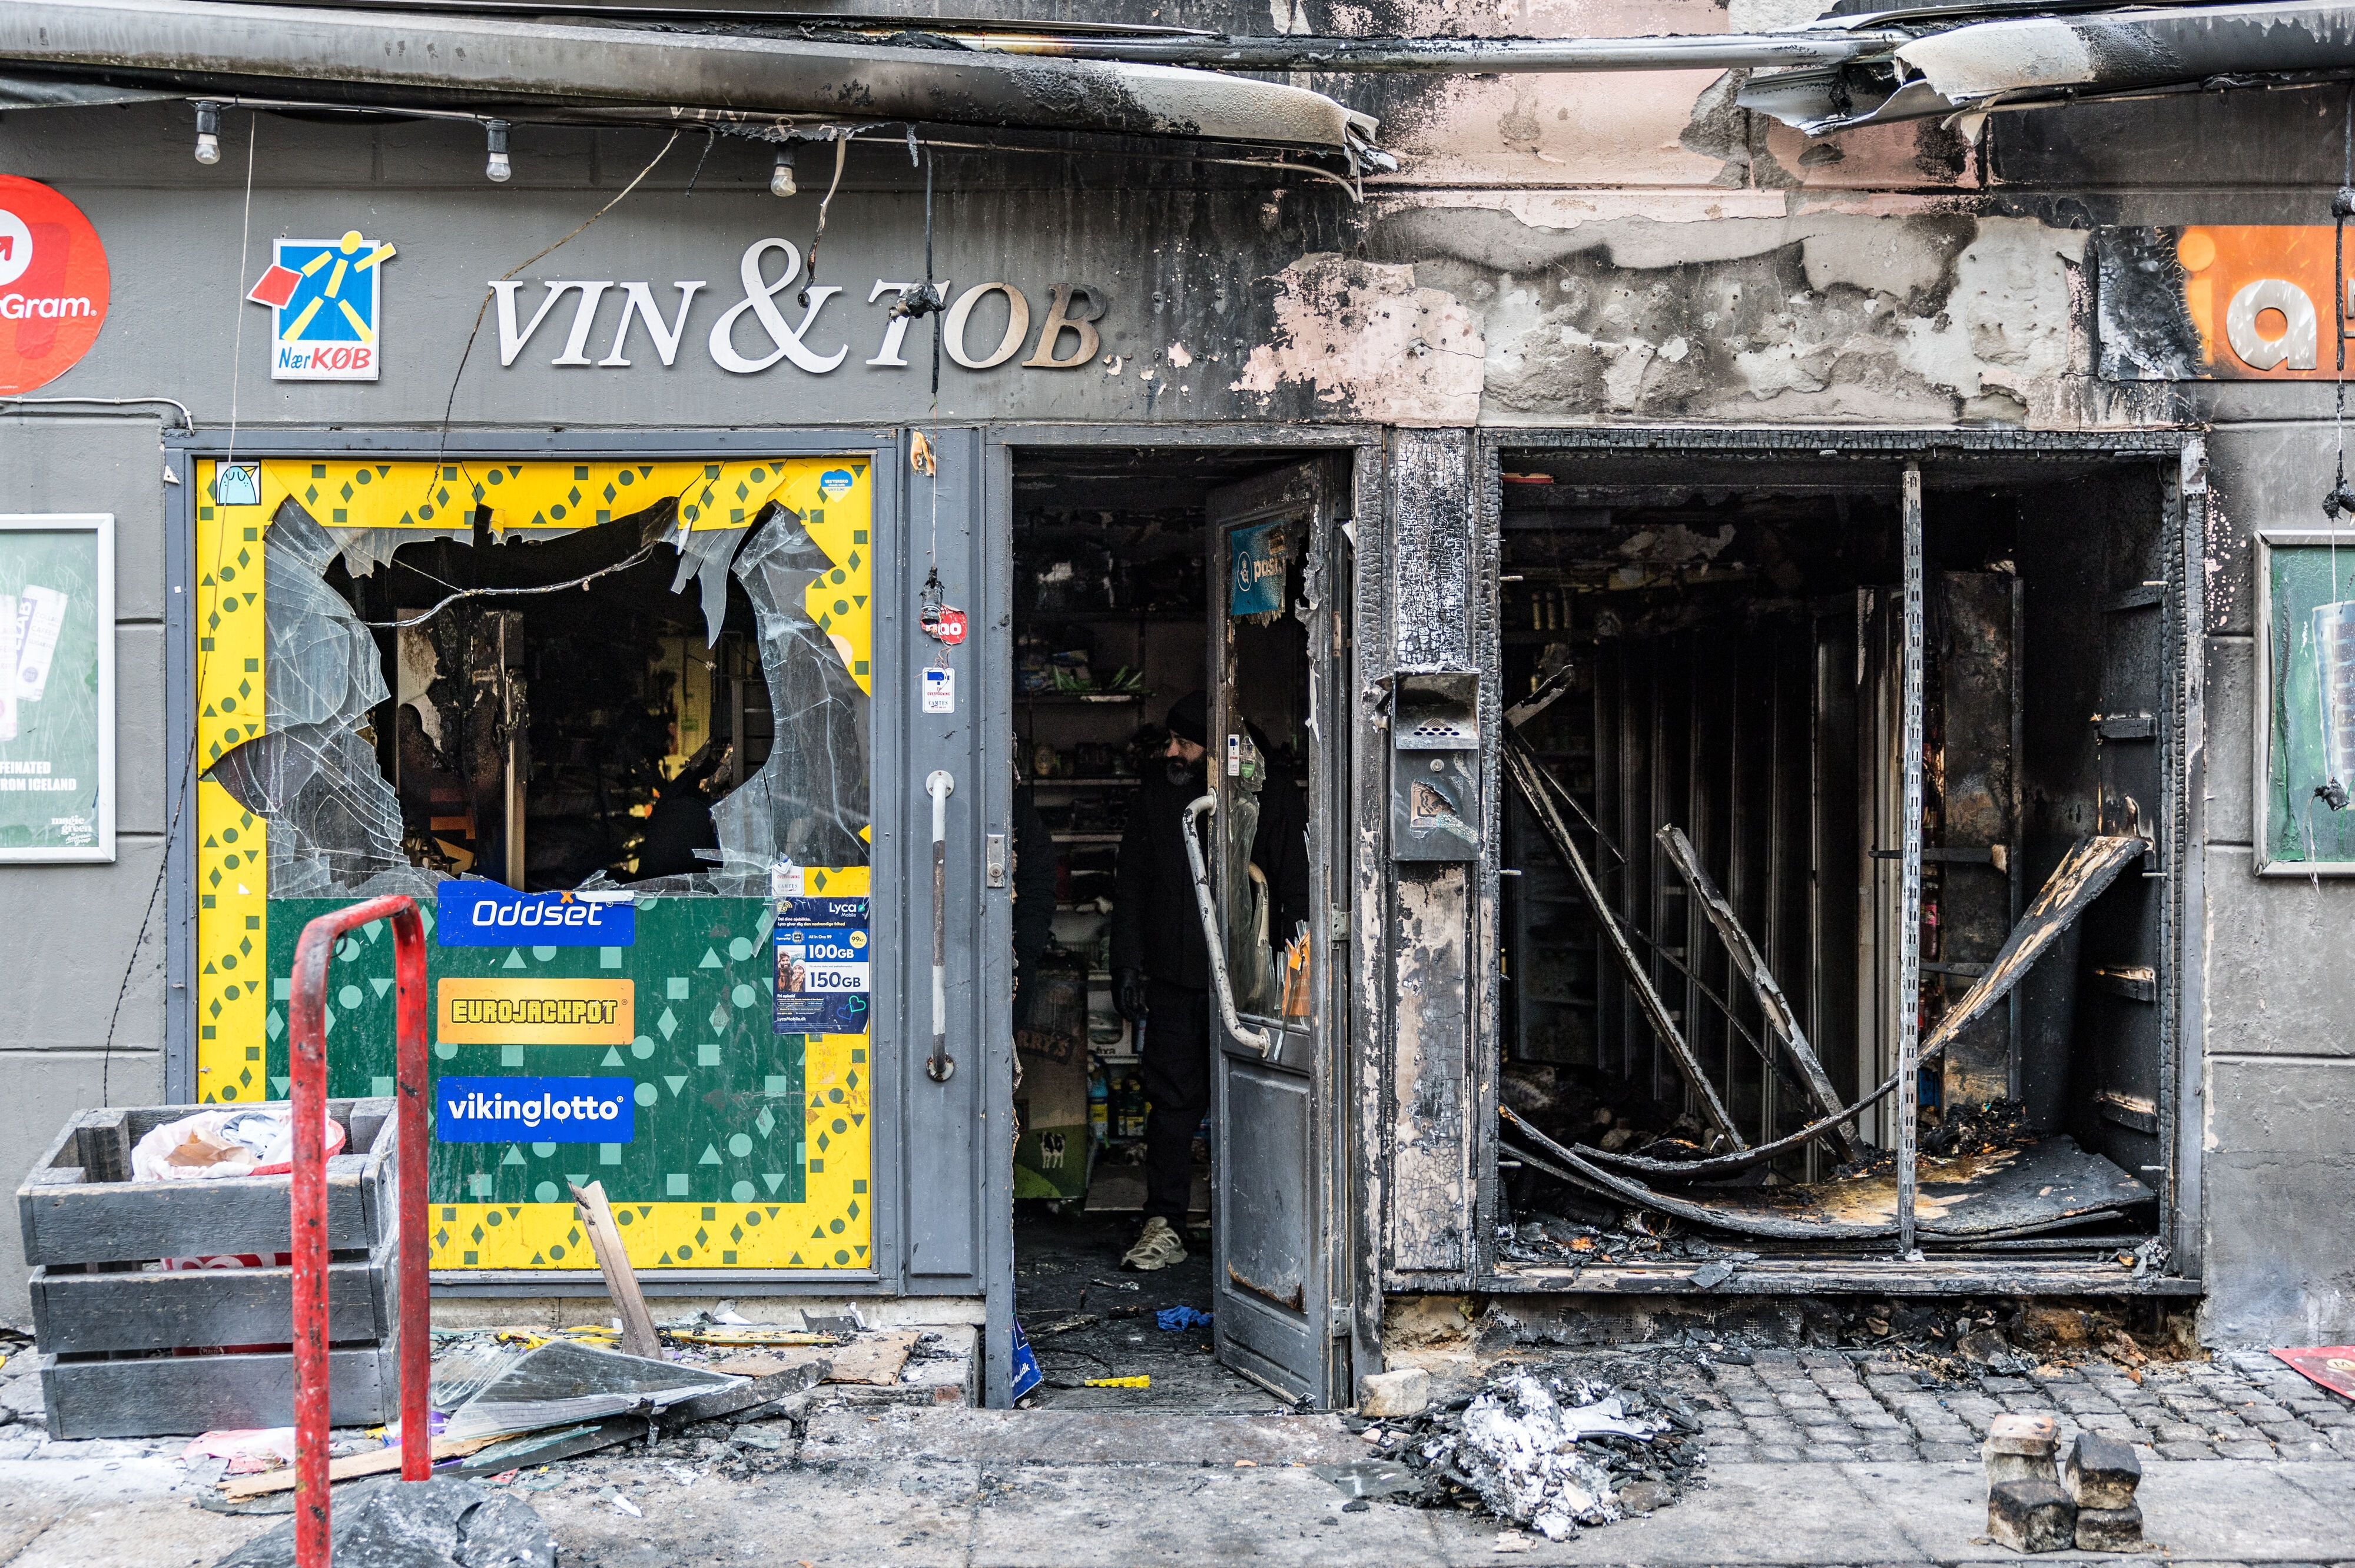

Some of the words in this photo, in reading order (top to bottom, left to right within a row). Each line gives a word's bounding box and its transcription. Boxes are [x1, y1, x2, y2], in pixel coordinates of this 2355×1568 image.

[0, 292, 91, 320] Gram
[488, 279, 708, 367] VIN
[708, 237, 849, 374] &
[865, 278, 1107, 368] TOB
[28, 778, 77, 791] ICELAND
[51, 815, 85, 828] magic
[61, 825, 92, 835] green
[472, 900, 603, 926] Oddset
[829, 902, 857, 914] Lyca
[808, 944, 854, 959] 100GB
[810, 972, 861, 988] 150GB
[450, 999, 618, 1024] EUROJACKPOT
[447, 1092, 619, 1128] vikinglotto
